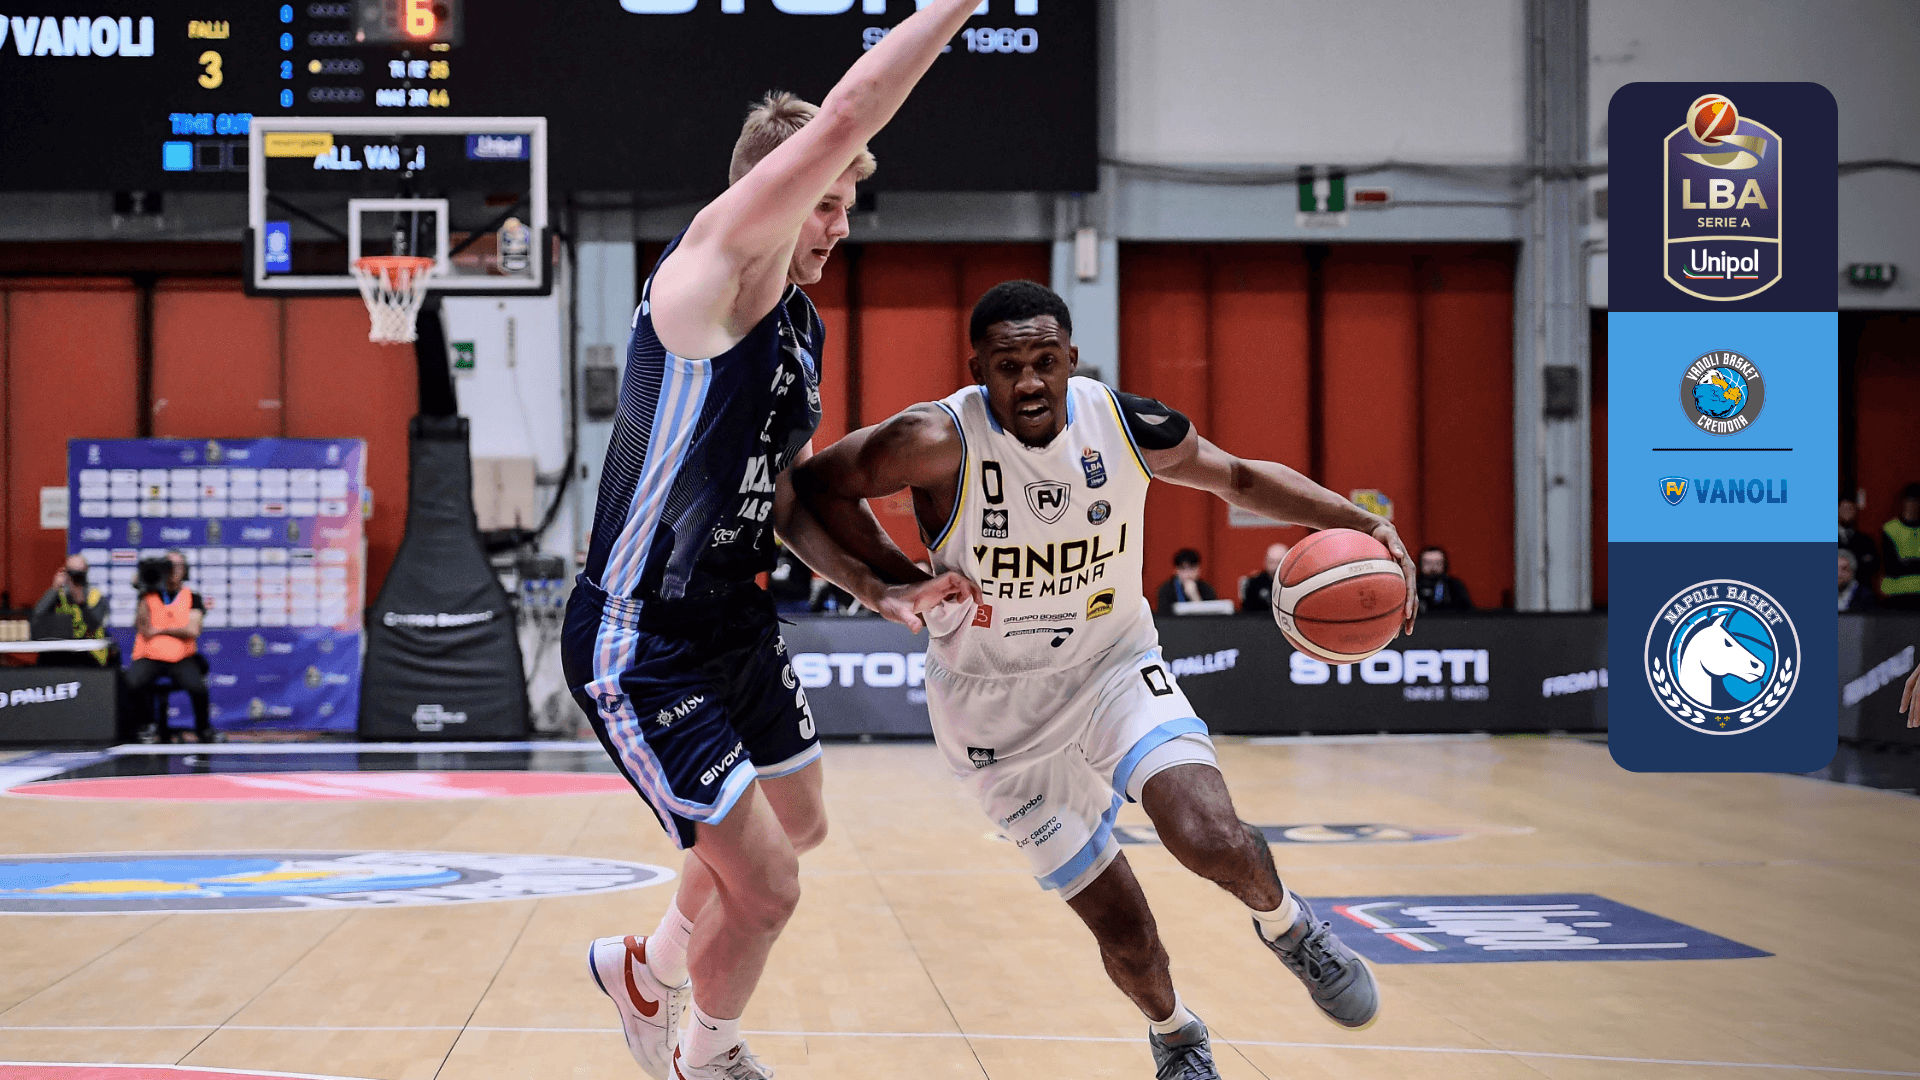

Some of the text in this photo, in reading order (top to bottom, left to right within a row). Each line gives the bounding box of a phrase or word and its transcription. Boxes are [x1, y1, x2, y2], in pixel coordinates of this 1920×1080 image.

[11, 16, 154, 57] VANOLI
[961, 27, 1039, 53] 1960
[198, 50, 223, 89] 3
[280, 60, 294, 79] 2
[169, 113, 215, 135] TIME
[1085, 462, 1103, 473] LBA
[982, 460, 1004, 505] 0
[983, 528, 1007, 538] errea
[973, 522, 1127, 579] VANOLI
[981, 562, 1105, 599] CREMONA
[1003, 612, 1078, 623] GRUPPO BOSSONI
[1140, 664, 1174, 697] 0
[10, 681, 81, 707] PALLET
[700, 741, 743, 786] GIVOVA
[1030, 815, 1057, 840] CREDITO
[1034, 822, 1062, 847] PADANO
